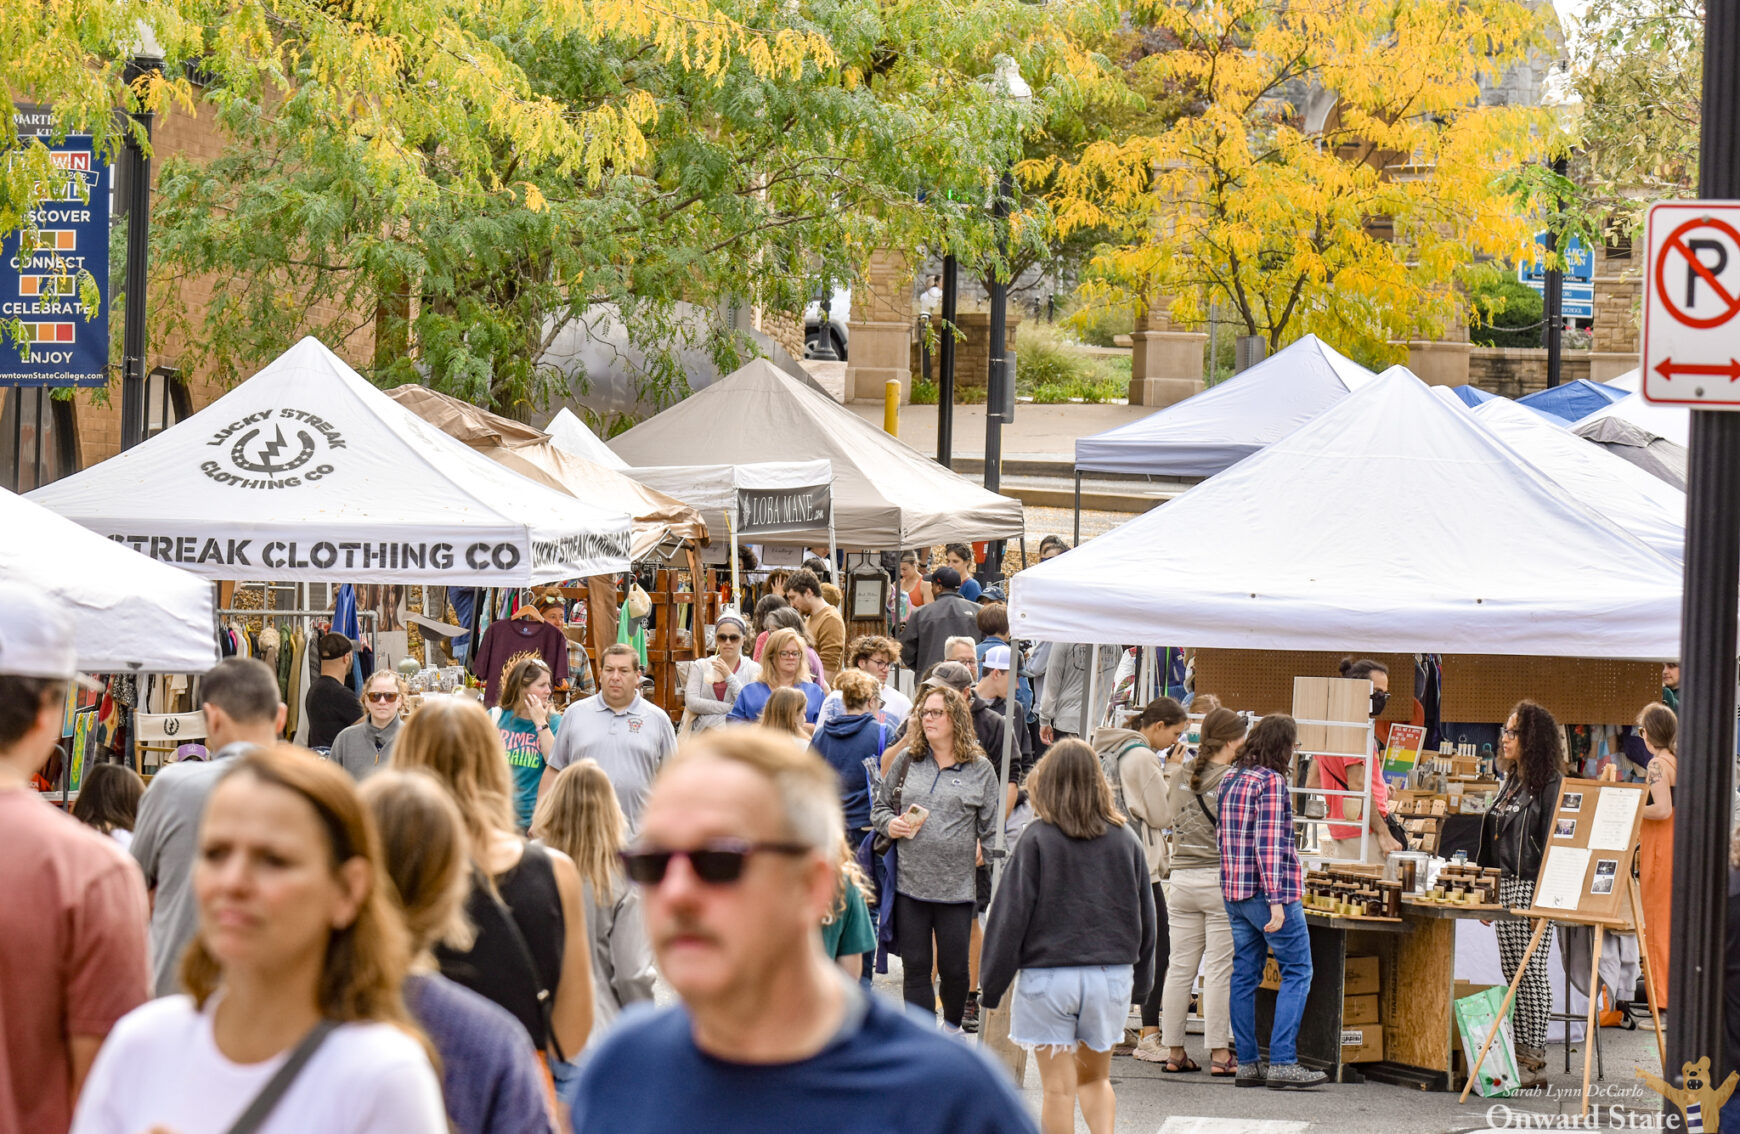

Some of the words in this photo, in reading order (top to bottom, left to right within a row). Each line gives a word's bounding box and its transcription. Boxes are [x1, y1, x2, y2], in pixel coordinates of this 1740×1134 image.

[24, 210, 91, 222] SCOVER
[10, 256, 86, 269] CONNECT
[206, 408, 274, 447] LUCKY
[279, 408, 348, 450] STREAK
[200, 460, 302, 490] CLOTHING
[304, 464, 335, 481] CO
[752, 496, 780, 526] LOBA
[783, 494, 813, 524] MANE
[107, 534, 252, 566] TREAK
[261, 541, 454, 570] CLOTHING
[465, 542, 521, 570] CO
